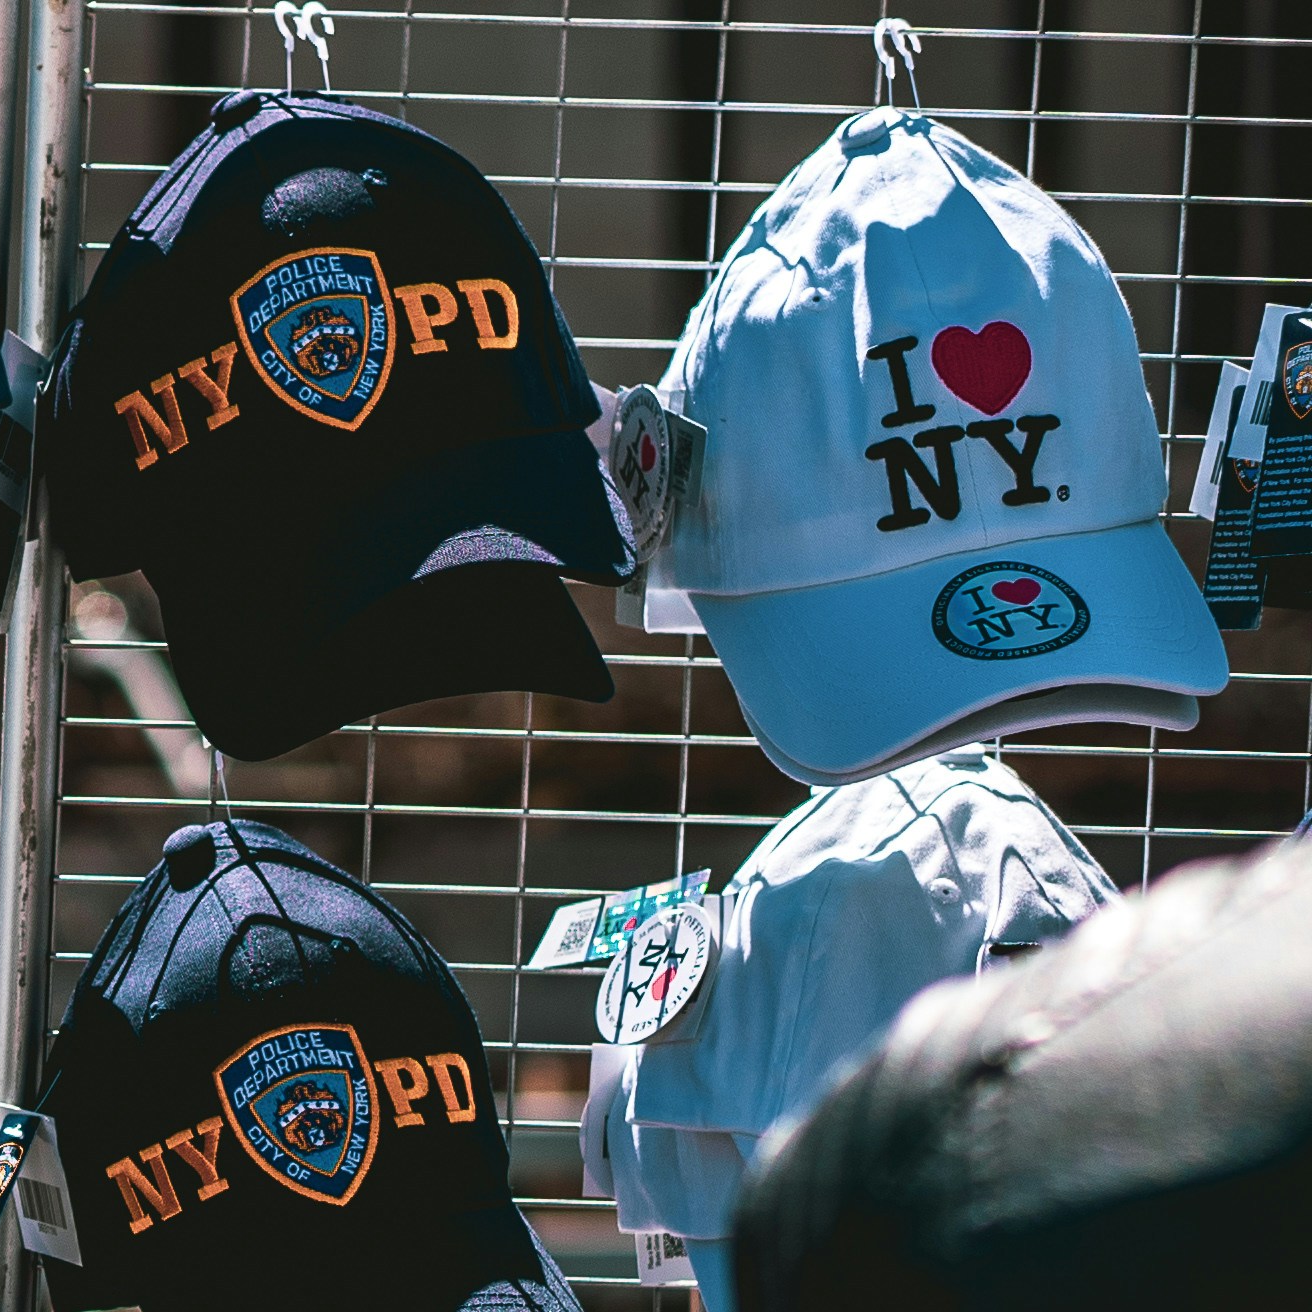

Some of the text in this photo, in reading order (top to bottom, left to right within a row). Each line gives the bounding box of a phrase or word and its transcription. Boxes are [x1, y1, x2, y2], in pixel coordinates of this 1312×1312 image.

[249, 273, 374, 334] DEPARTMENT
[265, 256, 344, 295] POLICE
[114, 278, 519, 471] NY PD
[261, 349, 322, 405] CITY OF
[353, 303, 386, 400] NEW YORK
[866, 336, 936, 428] I
[961, 585, 995, 616] I
[232, 1048, 354, 1110] DEPARTMENT
[247, 1031, 325, 1071] POLICE
[105, 1052, 476, 1234] NY PD
[247, 1125, 311, 1181] CITY OF
[340, 1077, 369, 1175] NEW YORK
